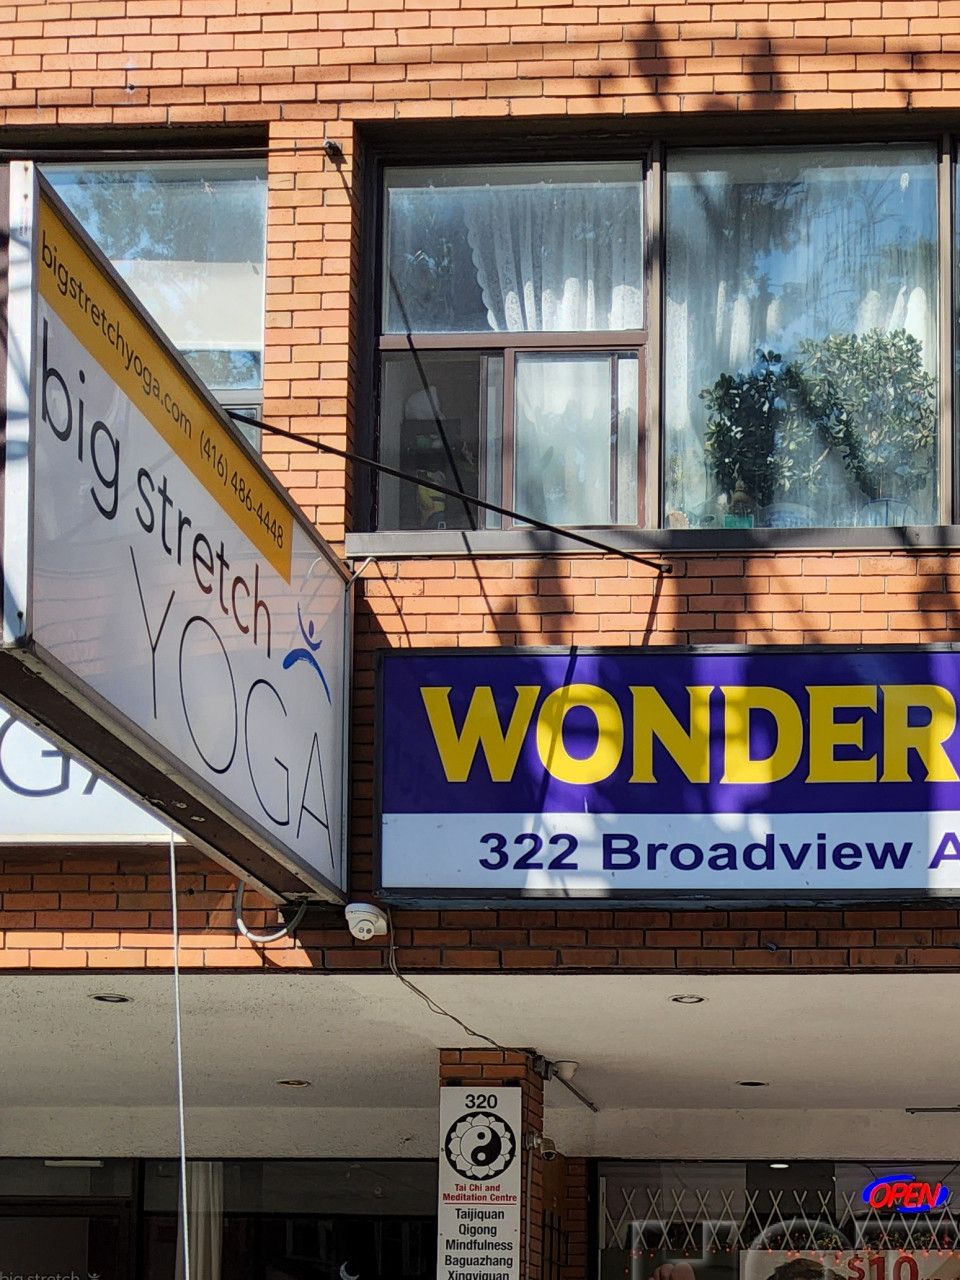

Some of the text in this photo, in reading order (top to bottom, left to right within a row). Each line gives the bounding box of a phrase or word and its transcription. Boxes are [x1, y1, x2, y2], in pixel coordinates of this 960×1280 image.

[41, 230, 285, 551] bigstretchyoga.com (416) 486-4448
[41, 318, 271, 659] big stretch
[130, 545, 335, 870] YOGA
[420, 682, 959, 786] WONDER
[478, 831, 579, 873] 322
[599, 826, 912, 875] Broadview
[464, 1094, 498, 1109] 320
[454, 1183, 501, 1192] Tai Chi and
[869, 1182, 941, 1208] OPEN
[442, 1193, 517, 1202] Meditation Centre
[455, 1208, 505, 1222] Taijiquan
[458, 1223, 497, 1237] Qigong
[445, 1239, 513, 1251] Mindfulness
[444, 1254, 513, 1269] Baguazhang
